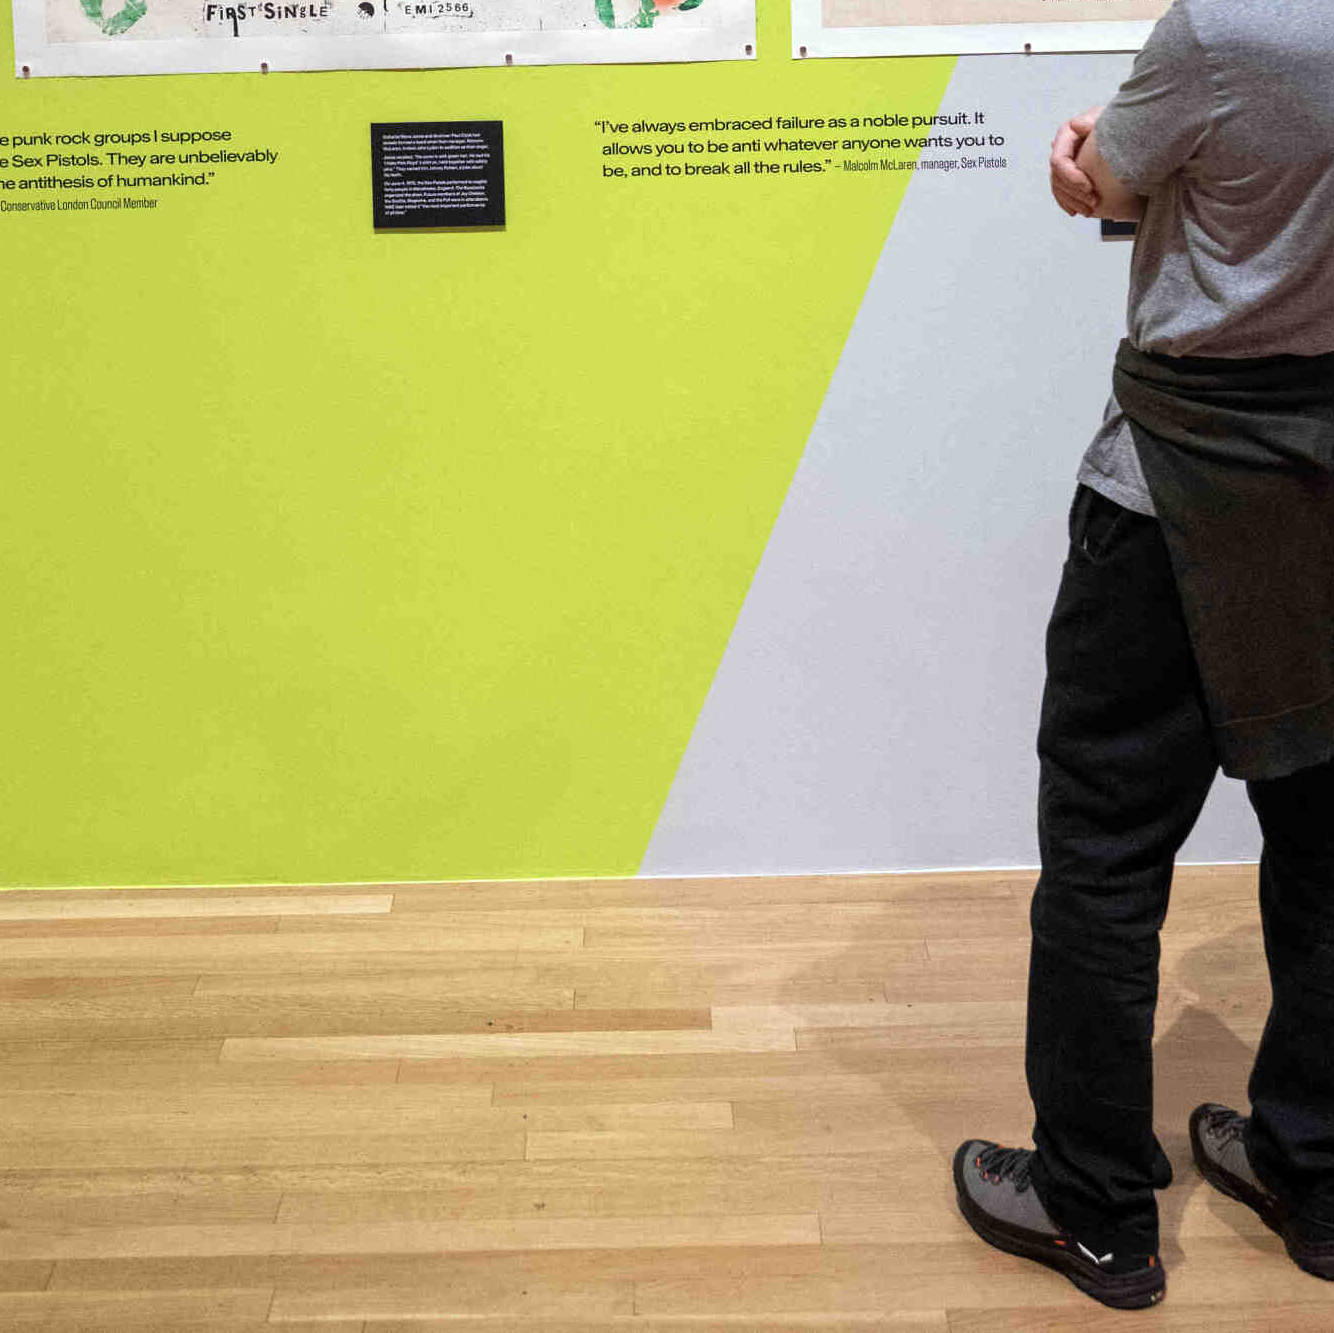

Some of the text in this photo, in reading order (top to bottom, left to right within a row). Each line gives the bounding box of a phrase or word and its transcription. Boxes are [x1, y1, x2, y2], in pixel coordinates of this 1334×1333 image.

[404, 2, 434, 16] EMI
[437, 1, 472, 15] 2566
[631, 118, 687, 136] always
[688, 115, 773, 133] embraced
[775, 115, 826, 131] failure
[827, 117, 848, 130] as
[849, 116, 860, 128] a
[862, 112, 909, 129] noble
[911, 111, 972, 130] pursuit.
[974, 110, 985, 125] It
[12, 131, 53, 150] punk
[55, 130, 91, 146] rock
[93, 131, 152, 148] groups
[153, 129, 158, 144] I
[160, 129, 232, 146] suppose
